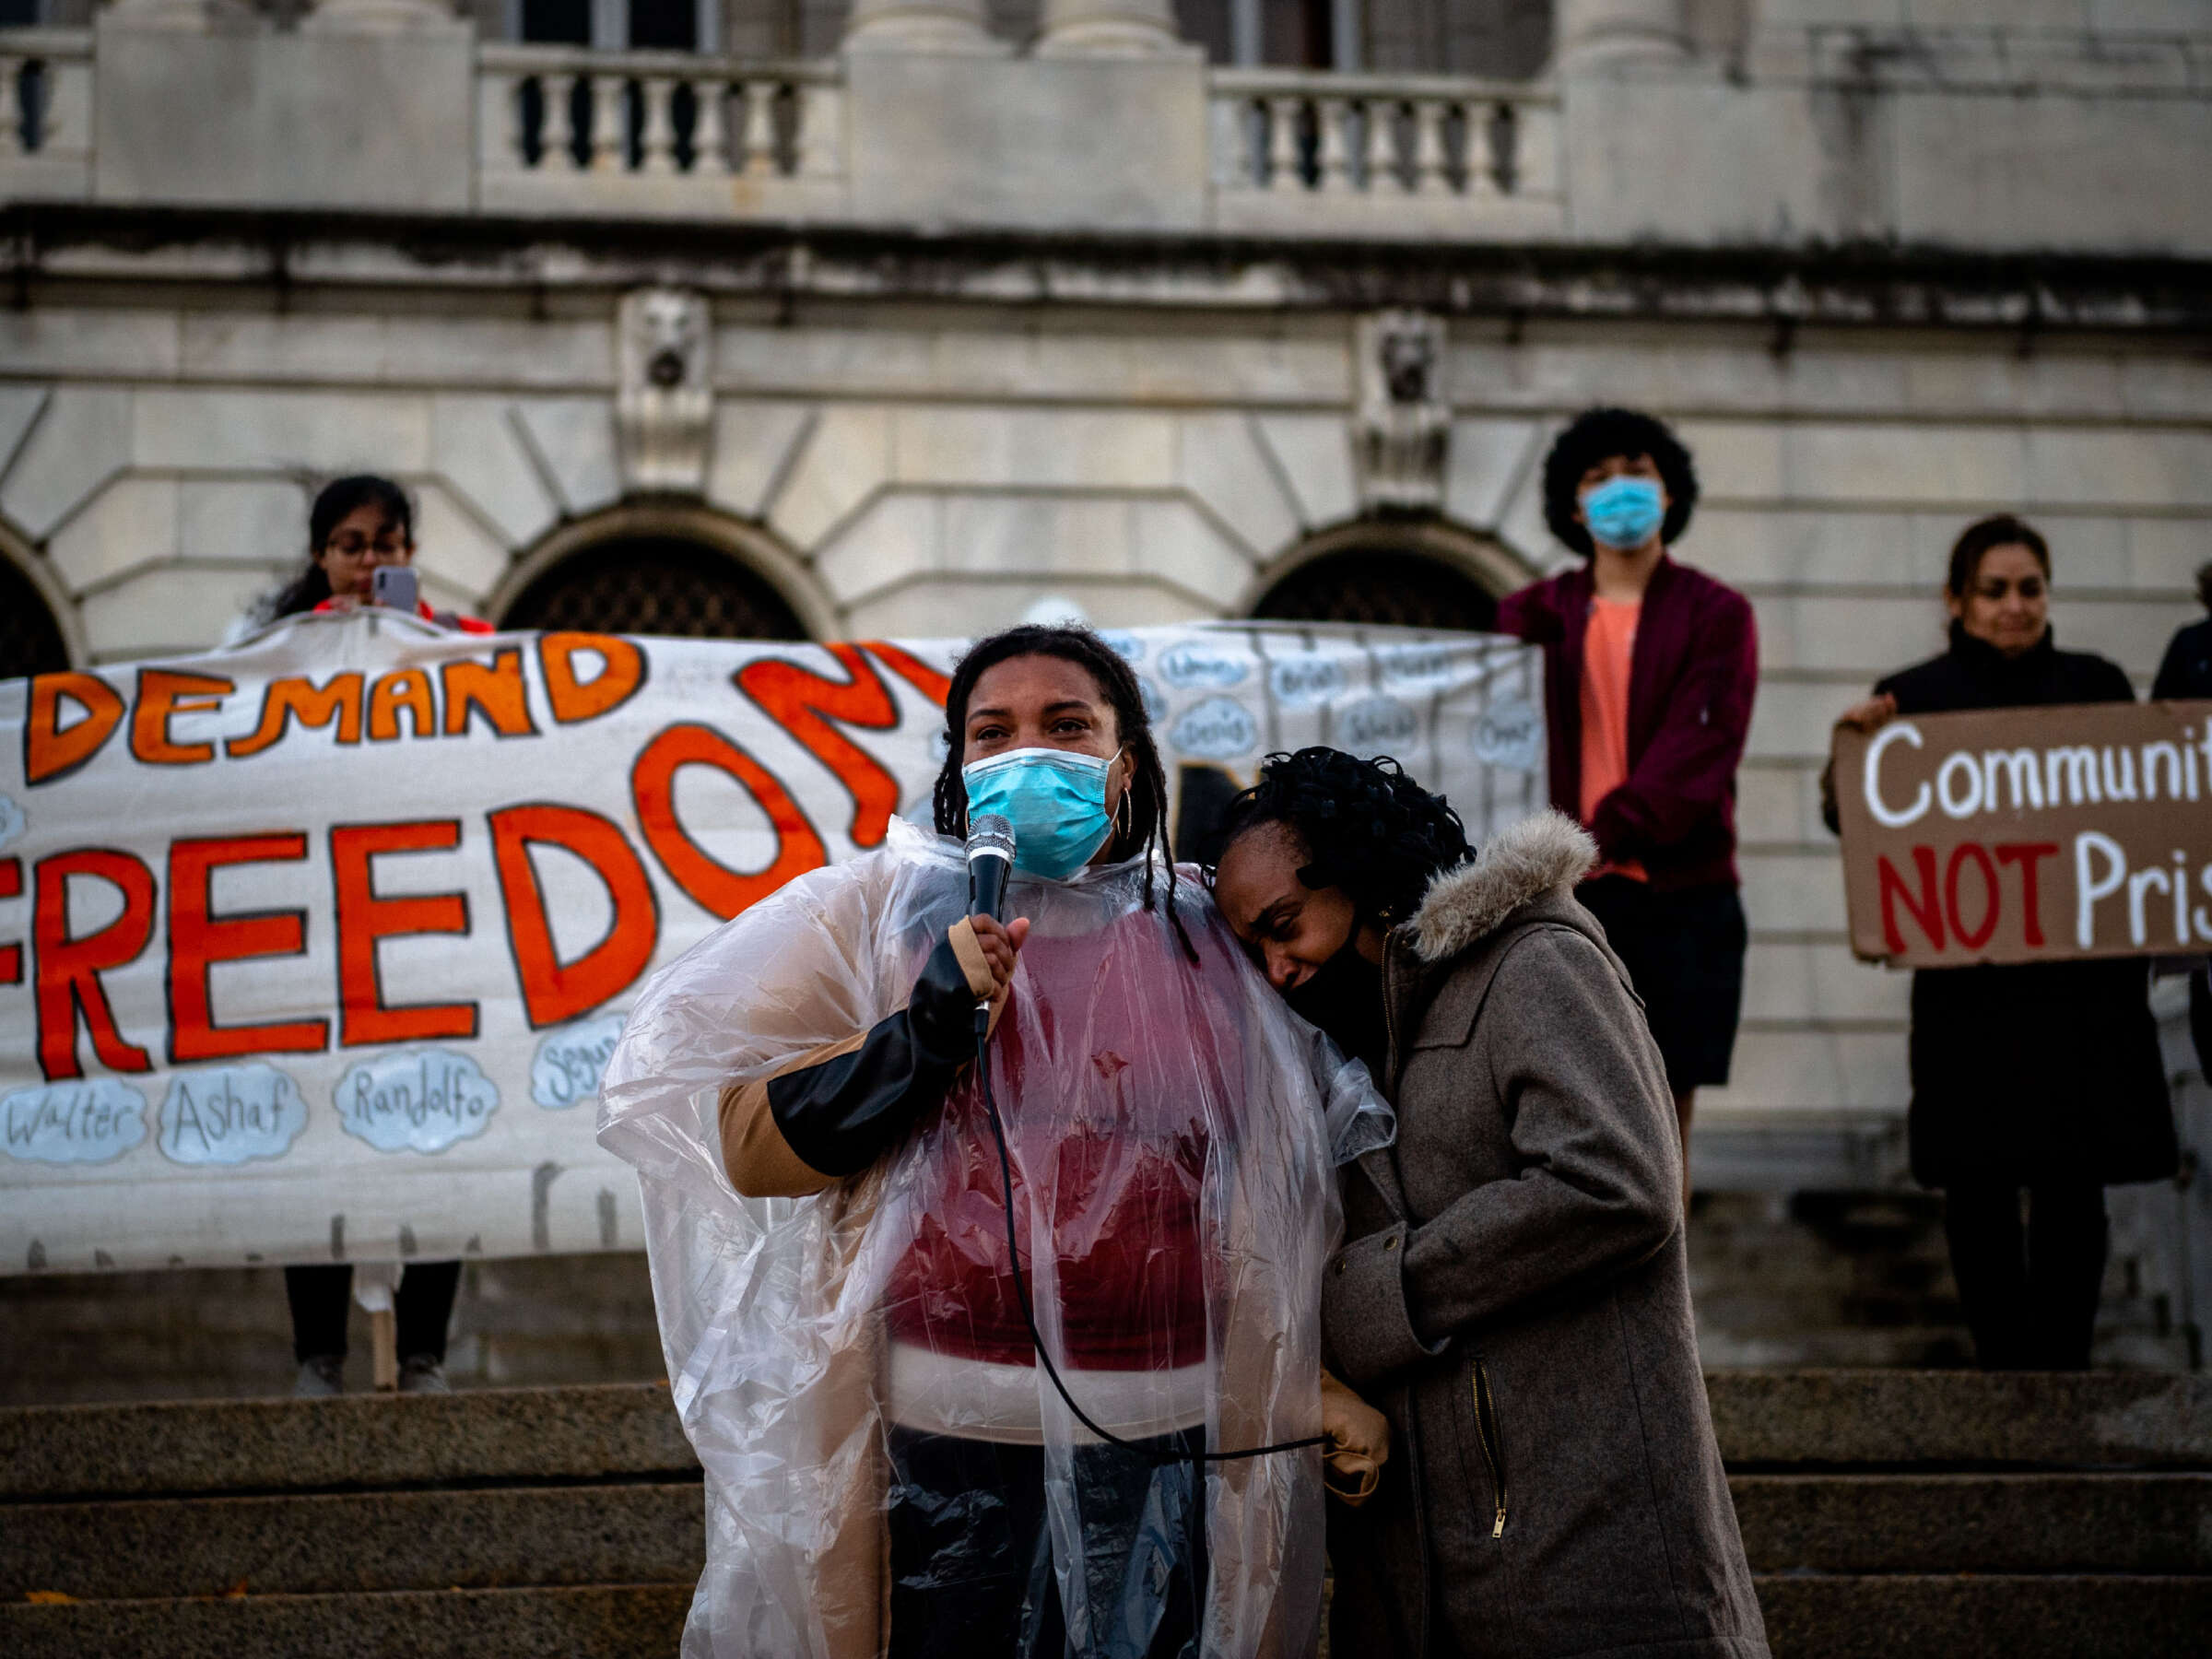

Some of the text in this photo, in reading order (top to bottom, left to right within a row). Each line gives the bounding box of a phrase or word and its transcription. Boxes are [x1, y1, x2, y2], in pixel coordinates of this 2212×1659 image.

[25, 630, 649, 786] DEMAND
[1877, 842, 2060, 955] NOT
[6, 1088, 134, 1145] Walter
[354, 1059, 485, 1128] Randolfo
